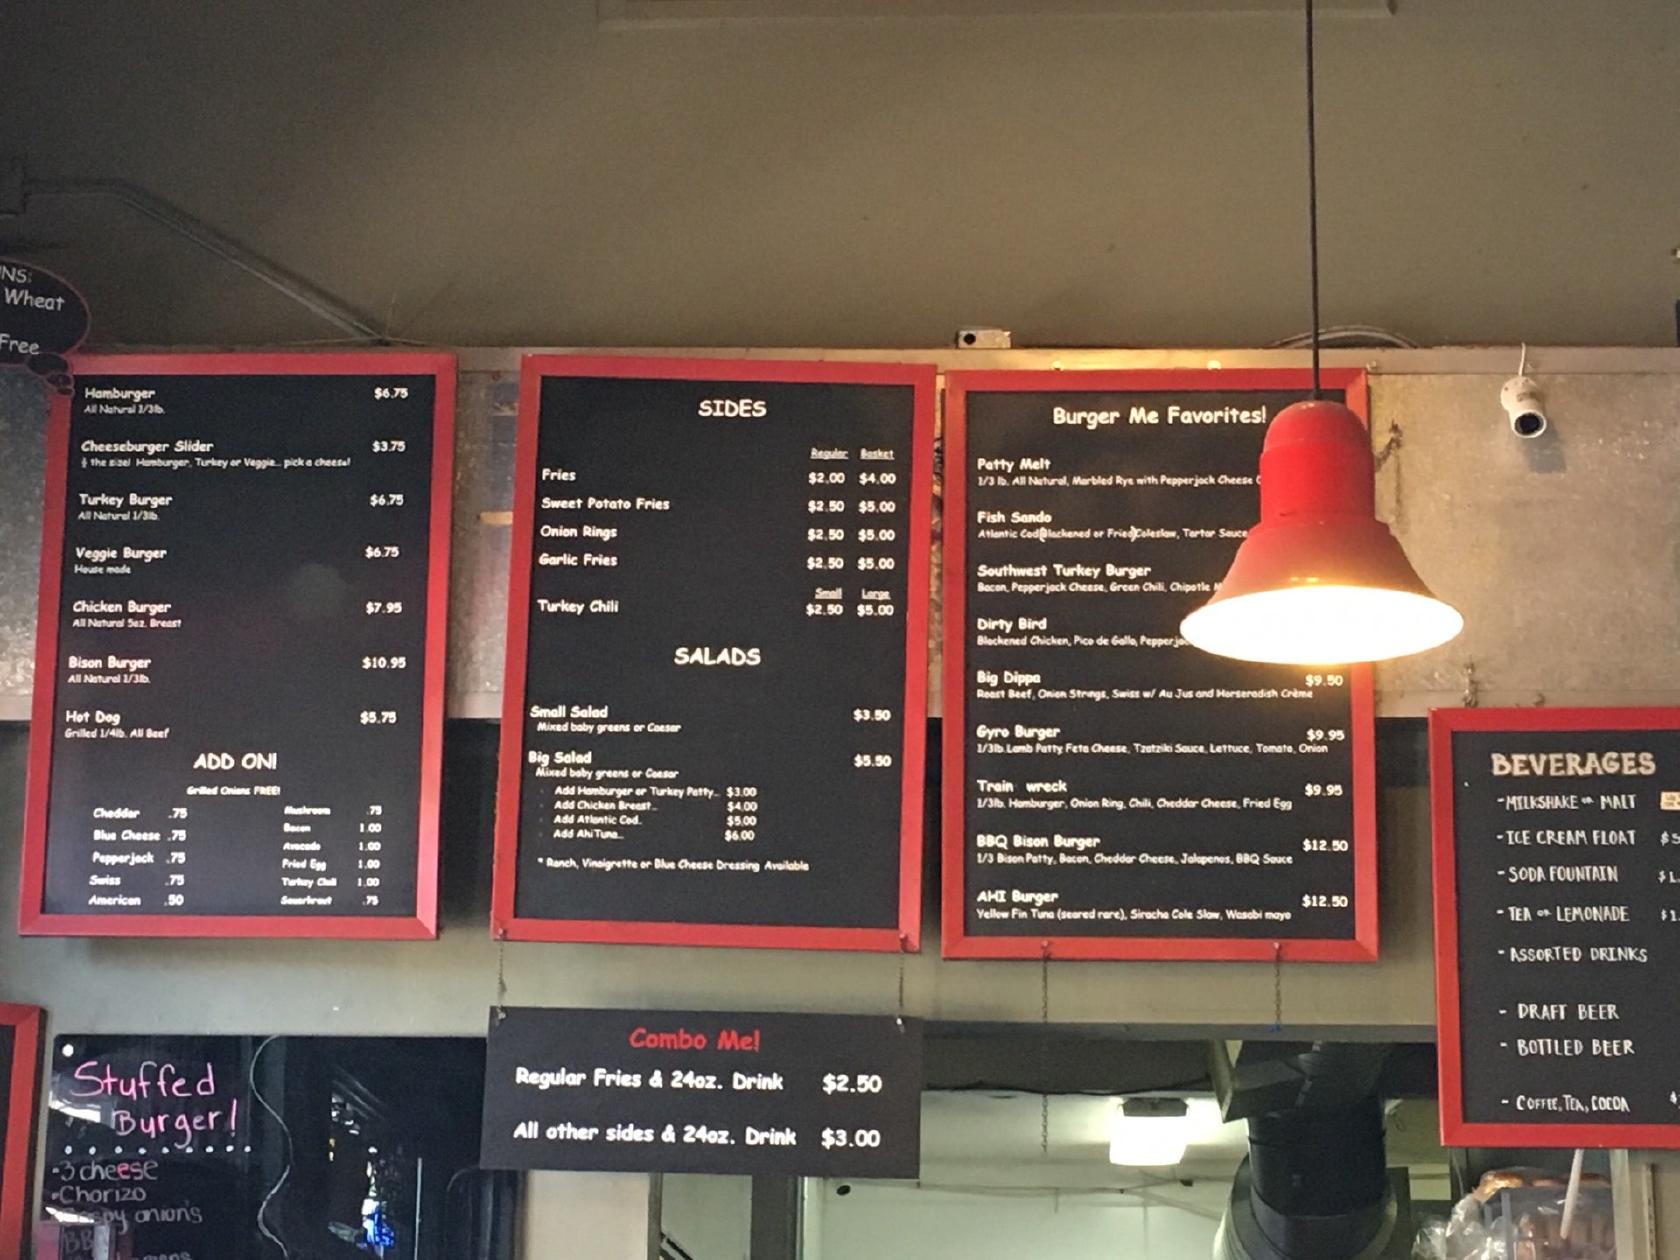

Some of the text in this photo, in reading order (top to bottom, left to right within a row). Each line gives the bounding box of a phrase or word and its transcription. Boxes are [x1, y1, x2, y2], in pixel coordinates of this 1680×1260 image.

[0, 266, 31, 283] NS:
[5, 287, 65, 311] Wheat
[0, 333, 39, 355] Free
[85, 387, 408, 402] Hamburger $6.75
[698, 399, 766, 417] SIDES
[1054, 406, 1266, 429] Burger Me Favorites!
[81, 440, 405, 455] Cheeseburger Slider $3.75
[978, 458, 1051, 473] Patty Melt
[542, 468, 896, 485] Fries $2.00 $4.00
[79, 493, 403, 508] Turkey Burger $6.75
[541, 497, 896, 514] Sweet Potato Fries $2.50 $5.00
[977, 511, 1052, 523] Fish Sando
[540, 525, 895, 542] Onion Rings $2.50 $5.00
[76, 546, 399, 562] Veggie Burger $6.75
[539, 553, 895, 570] Garlic Fries $2.50 $5.00
[977, 564, 1151, 579] Southwest Turkey Burger
[73, 600, 402, 616] Chicken Burger $7.95
[537, 599, 894, 617] Turkey Chili $2.50 $5.00
[977, 618, 1047, 632] Dirty Bird
[69, 655, 406, 672] Bison Burger $10.95
[674, 647, 761, 666] SALADS
[977, 670, 1343, 687] Big Dippa $9.50
[66, 710, 396, 726] Hot Dog $5.75
[530, 705, 891, 722] Small Salad $3.50
[537, 722, 569, 731] Mixed
[571, 721, 594, 732] baby
[597, 724, 630, 734] greens
[647, 723, 681, 732] Caesar
[977, 725, 1345, 742] Gyro Burger $9.95
[193, 753, 277, 770] ADD ON!
[528, 751, 892, 767] Big Salad $5.50
[1491, 752, 1656, 776] BEVERAGES
[977, 780, 1343, 796] Train wreck $9.95
[1070, 798, 1100, 808] Onion
[1157, 798, 1199, 808] Cheddar
[1243, 798, 1271, 808] Fried
[1273, 797, 1292, 810] Egg
[93, 808, 140, 818] Cheddar
[94, 830, 116, 840] Blue
[121, 830, 160, 841] Cheese
[977, 834, 1348, 852] BBQ Bison Burger $12.50
[1506, 830, 1635, 845] ICE CREAM FLOAT
[93, 851, 154, 865] Pepperjack
[89, 875, 121, 885] Swiss
[1509, 866, 1618, 882] SODA FOUNTAIN
[88, 894, 141, 905] American
[977, 889, 1348, 908] AHI Burger $12.50
[1508, 906, 1532, 921] TEA
[1557, 906, 1629, 922] LEMONADE
[1510, 946, 1647, 962] ASSORTED DRINKS
[1518, 1004, 1619, 1020] DRAFT BEER
[629, 1027, 760, 1051] Combo Me!
[1517, 1039, 1634, 1056] BOTTLED BEER
[71, 1061, 216, 1100] Stuffed
[516, 1067, 882, 1095] Regular Fries & 24oz. Drink $2.50
[117, 1098, 237, 1148] Burger!
[514, 1120, 880, 1149] All other sides & 24oz. Drink $3.00
